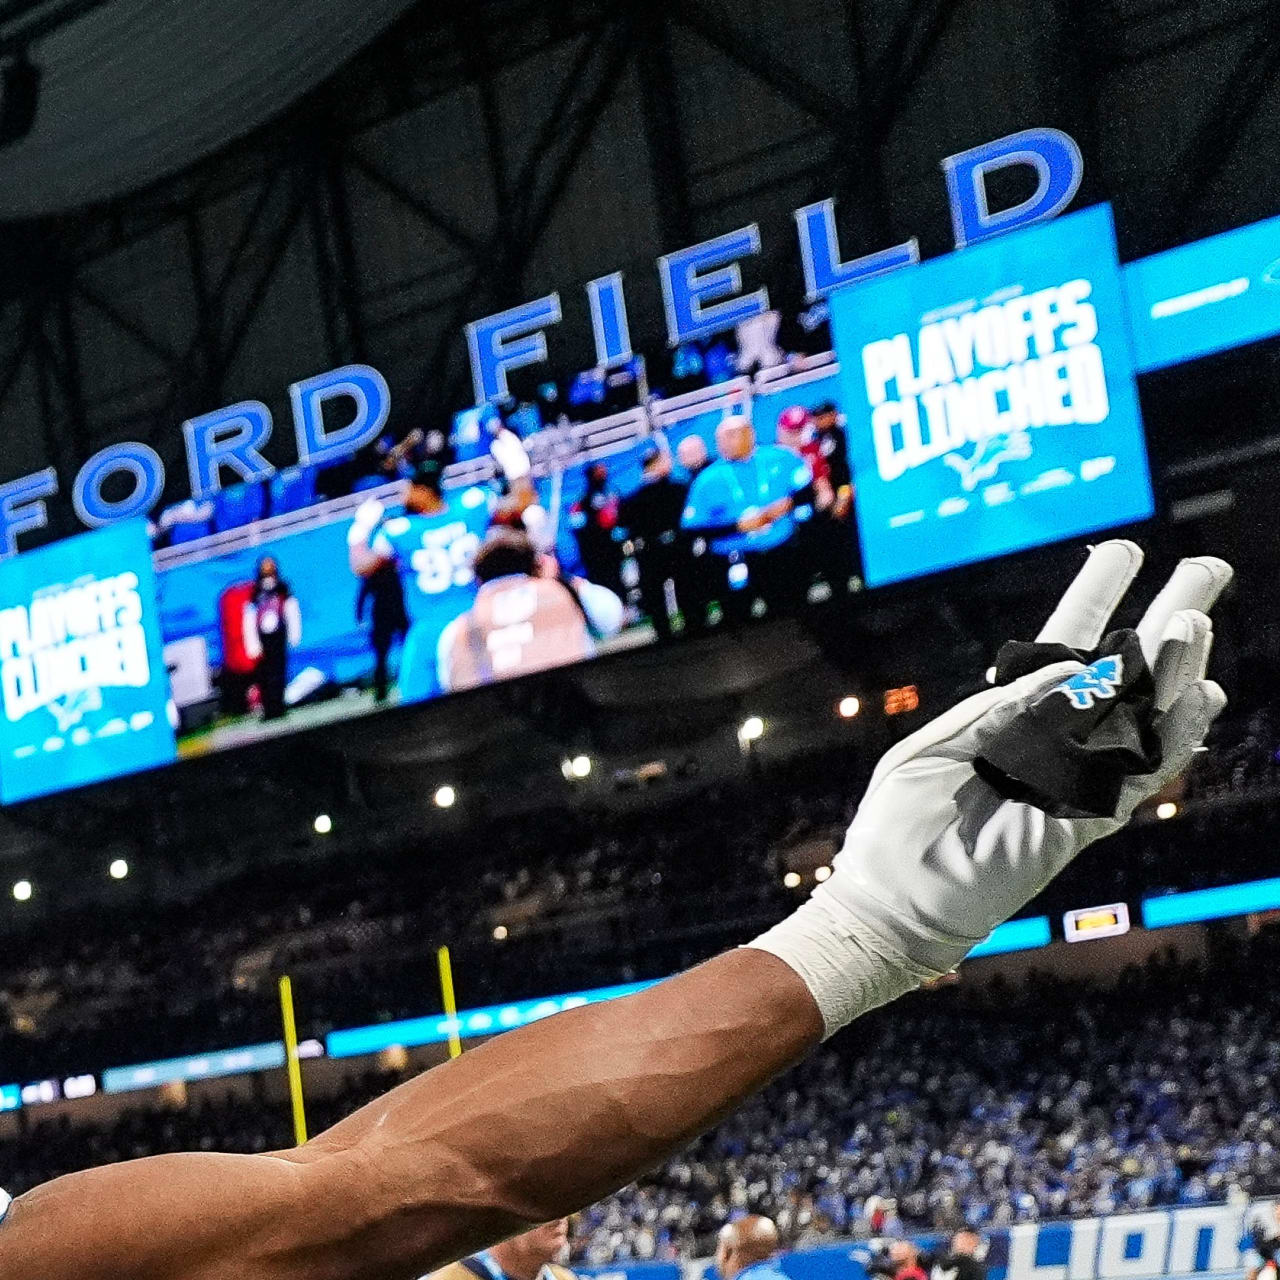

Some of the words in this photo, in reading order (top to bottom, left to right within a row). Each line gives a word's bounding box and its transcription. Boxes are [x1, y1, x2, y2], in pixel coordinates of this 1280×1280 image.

[465, 127, 1083, 406] FIELD
[861, 278, 1098, 406] PLAYOFFS
[871, 342, 1109, 481] CLINCHED
